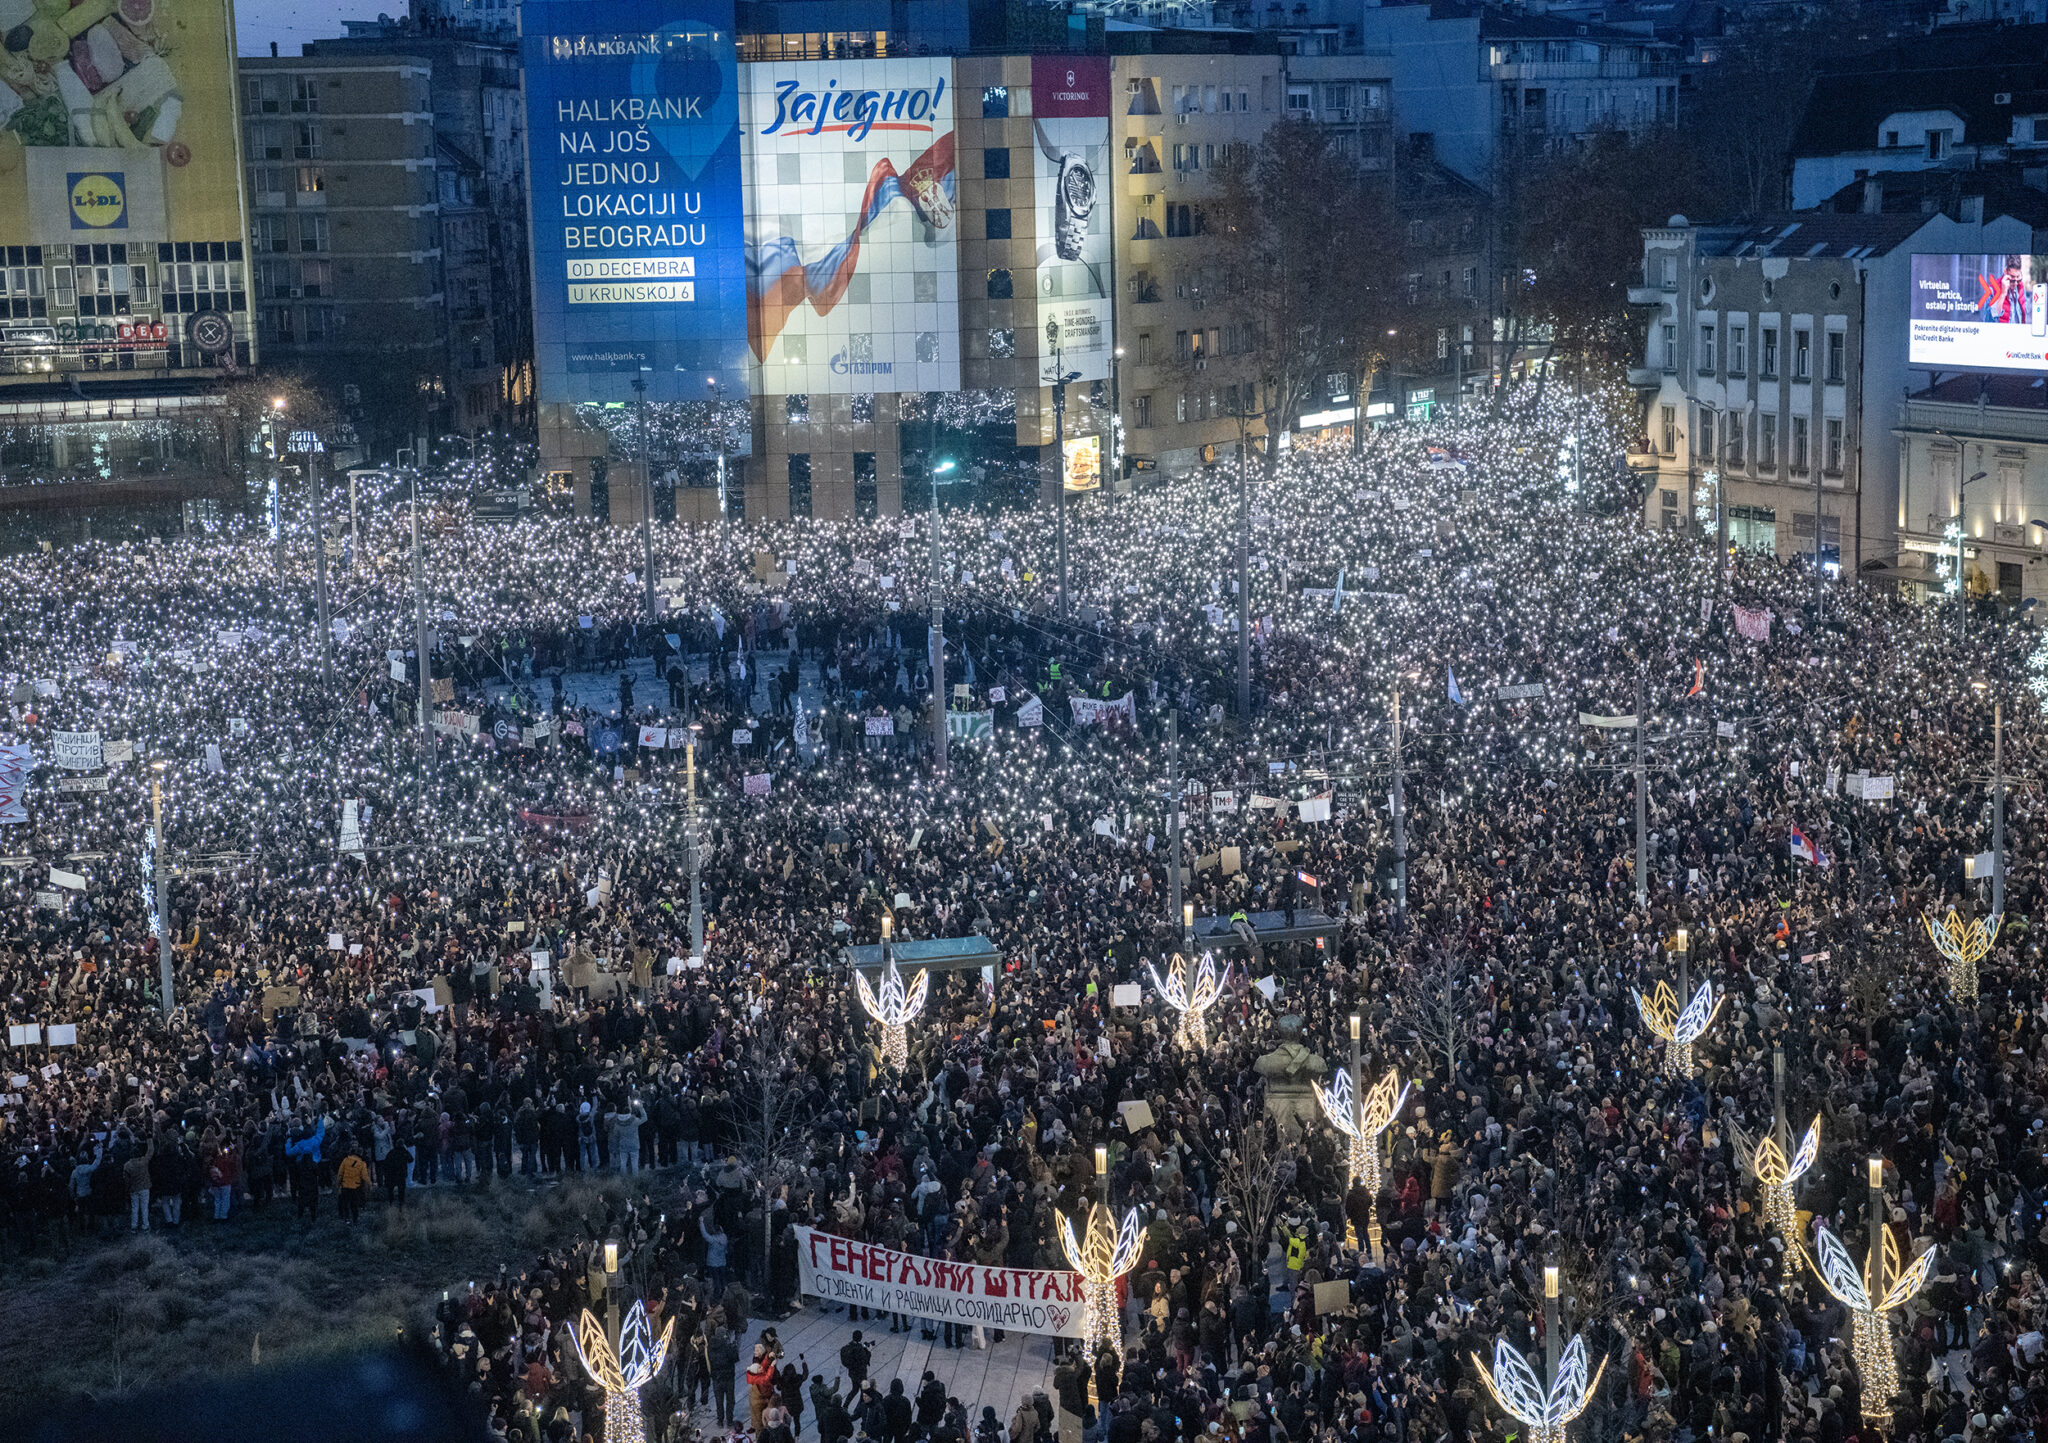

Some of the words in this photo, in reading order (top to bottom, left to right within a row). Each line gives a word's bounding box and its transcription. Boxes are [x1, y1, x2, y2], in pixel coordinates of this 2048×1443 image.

[574, 40, 661, 56] HALKBANK
[1052, 92, 1089, 100] VICTORINOX
[558, 97, 702, 121] HALKBANK
[560, 131, 596, 154] NA
[603, 123, 650, 153] JOŠ
[561, 162, 660, 185] JEDNOJ
[563, 193, 676, 217] LOKACIJI
[685, 192, 700, 214] U
[565, 223, 706, 248] BEOGRADU
[572, 263, 594, 277] OD
[600, 261, 690, 276] DECEMBRA
[1919, 280, 1950, 290] Virtuelna
[573, 288, 584, 301] U
[590, 286, 676, 301] KRUNSKOJ
[681, 286, 689, 299] 6
[1937, 290, 1962, 301] kartica,
[1925, 301, 1946, 310] ostalo
[1947, 302, 1954, 312] je
[1955, 302, 1979, 313] istorija
[1914, 324, 1938, 332] Pokrenite
[1939, 324, 1962, 334] digitalne
[1962, 325, 1979, 335] usluge
[1914, 334, 1938, 342] UniCredit
[571, 352, 645, 361] www.halkbank.rs
[849, 362, 893, 374] ГАЗПРОМ
[57, 743, 99, 756] ПРОТИВ
[809, 1233, 975, 1294] ГЕНЕРАЛНИ
[816, 1274, 873, 1302] СТУДЕНТИ
[881, 1287, 891, 1309] И
[896, 1289, 952, 1317] РАДНИЦИ
[955, 1298, 1046, 1329] СОЛИДАРНО
